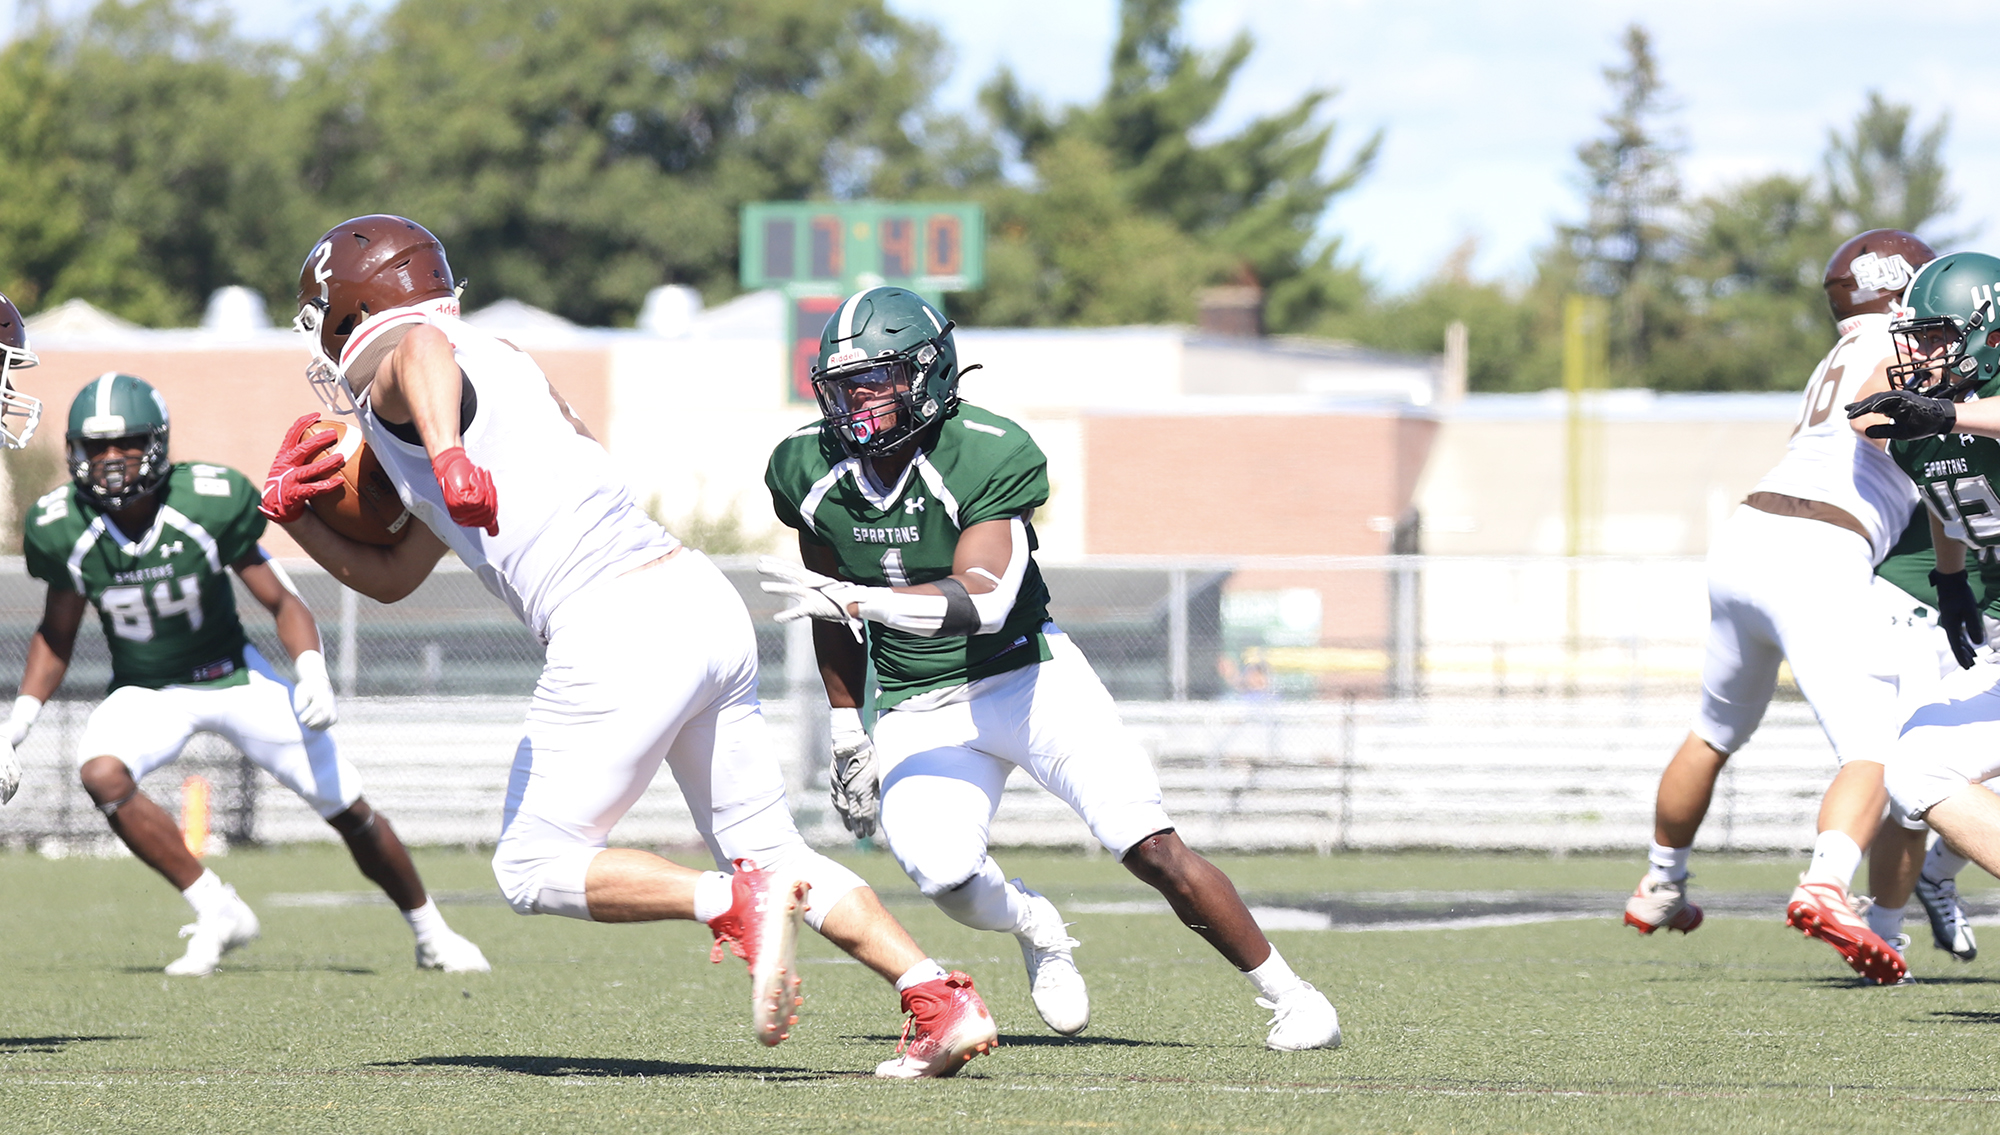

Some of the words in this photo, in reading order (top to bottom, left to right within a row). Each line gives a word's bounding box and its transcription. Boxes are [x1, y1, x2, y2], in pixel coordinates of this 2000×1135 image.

[314, 241, 333, 284] 2
[830, 351, 860, 364] Riddell
[1924, 458, 1968, 478] SPARTANS
[853, 526, 920, 543] SPARTANS
[113, 562, 175, 584] SPARTANS
[880, 548, 912, 587] 1
[100, 573, 205, 644] 84
